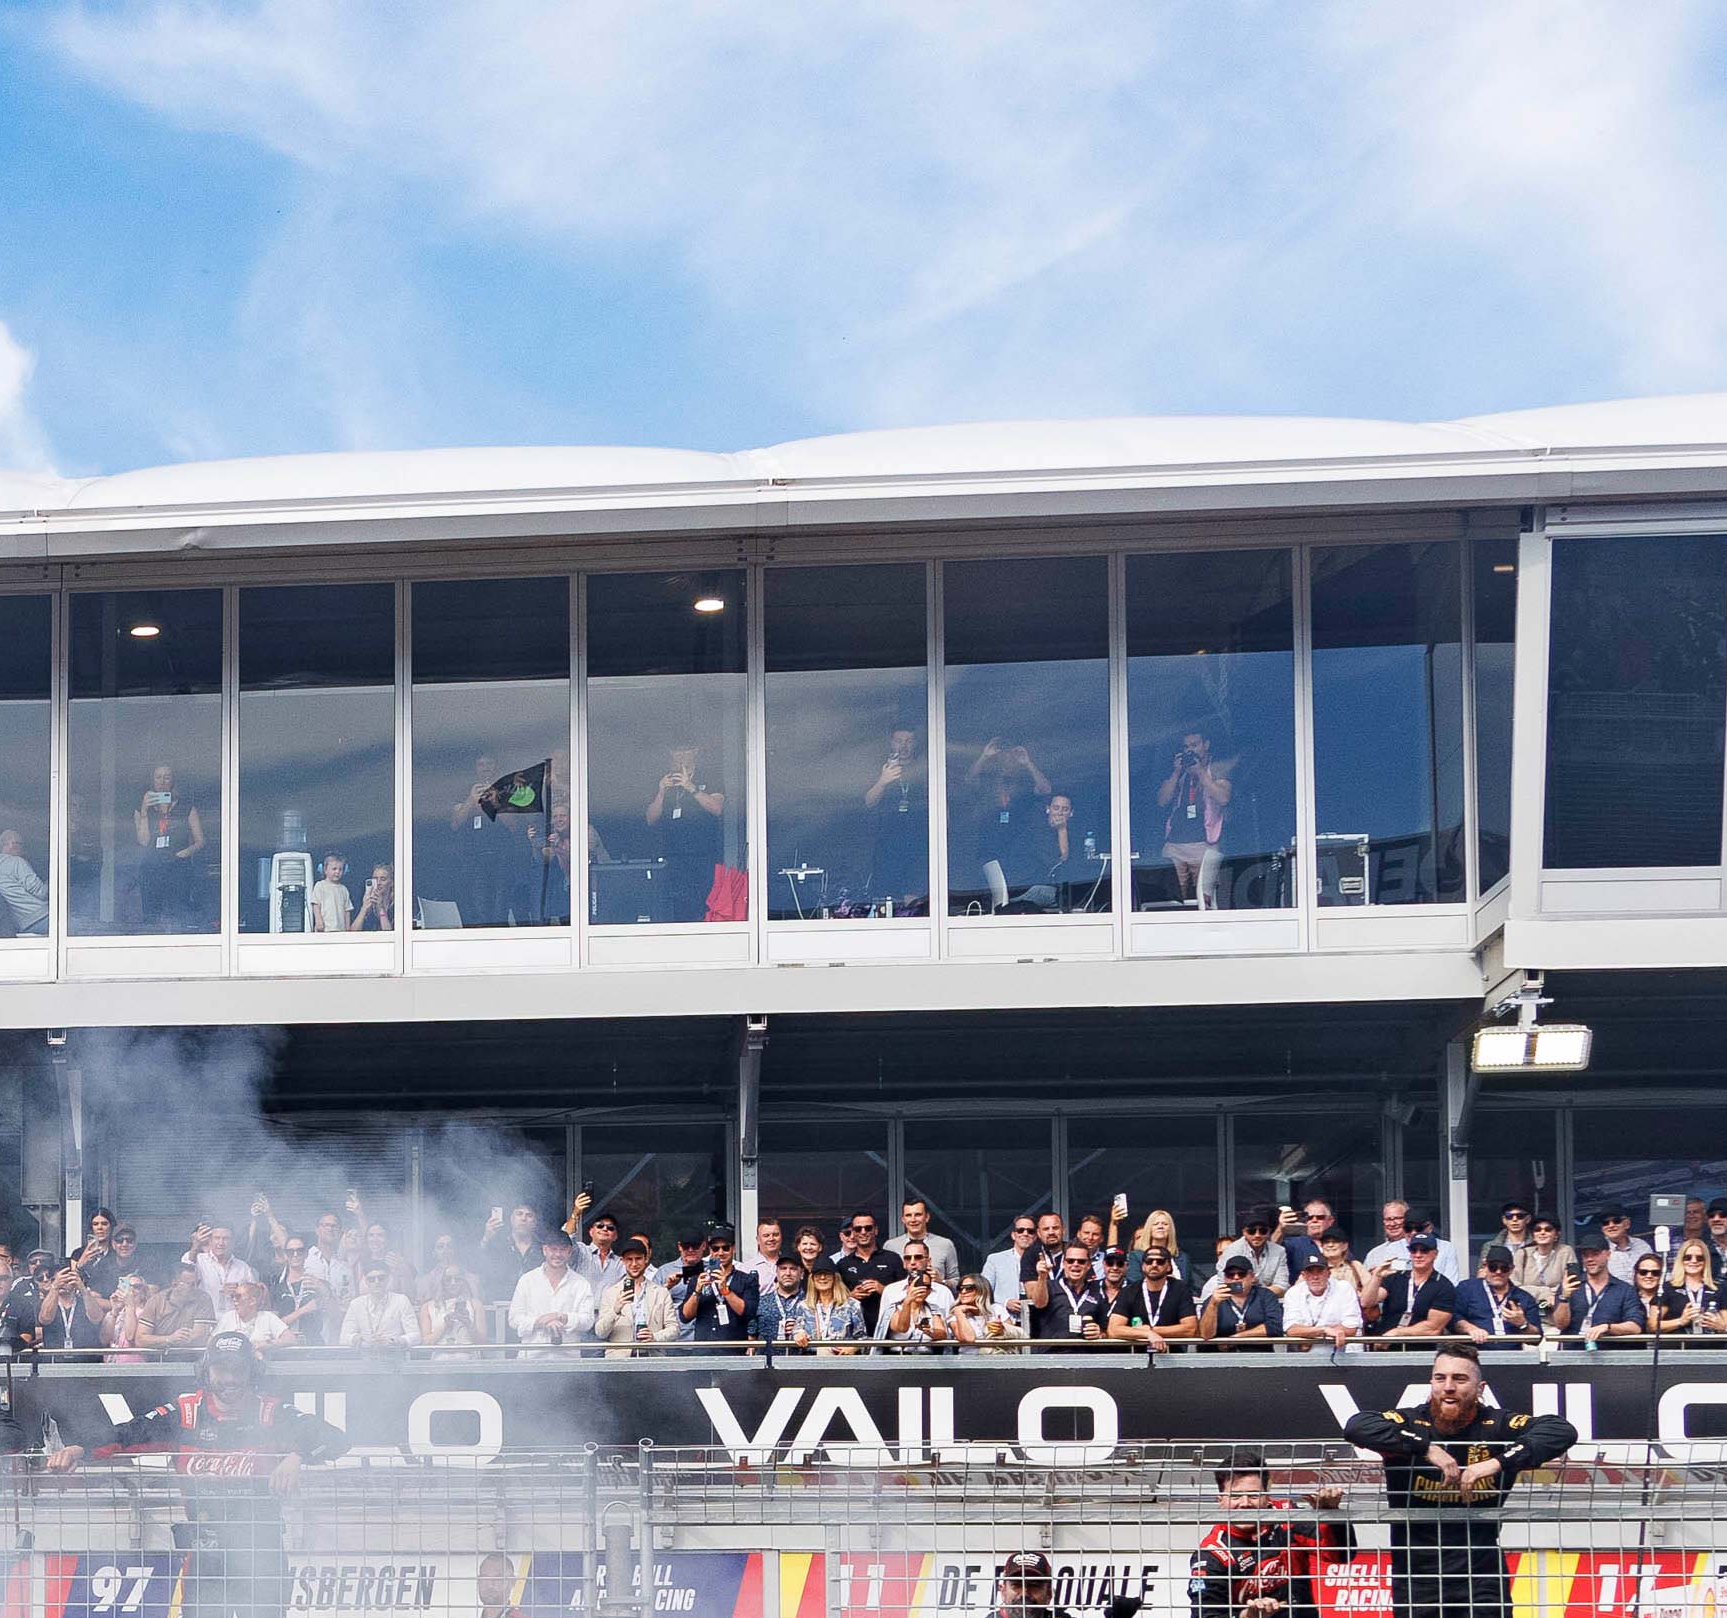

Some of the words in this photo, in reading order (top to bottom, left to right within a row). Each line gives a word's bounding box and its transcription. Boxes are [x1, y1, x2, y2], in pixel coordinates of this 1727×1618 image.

[696, 1386, 1118, 1464] VAILO
[92, 1566, 154, 1612] 97
[631, 1564, 673, 1586] BLL
[841, 1564, 885, 1611] 11
[939, 1565, 981, 1610] DE
[990, 1565, 1159, 1611] QUALE
[1324, 1564, 1380, 1587] SHELL
[1334, 1589, 1394, 1612] RACIN
